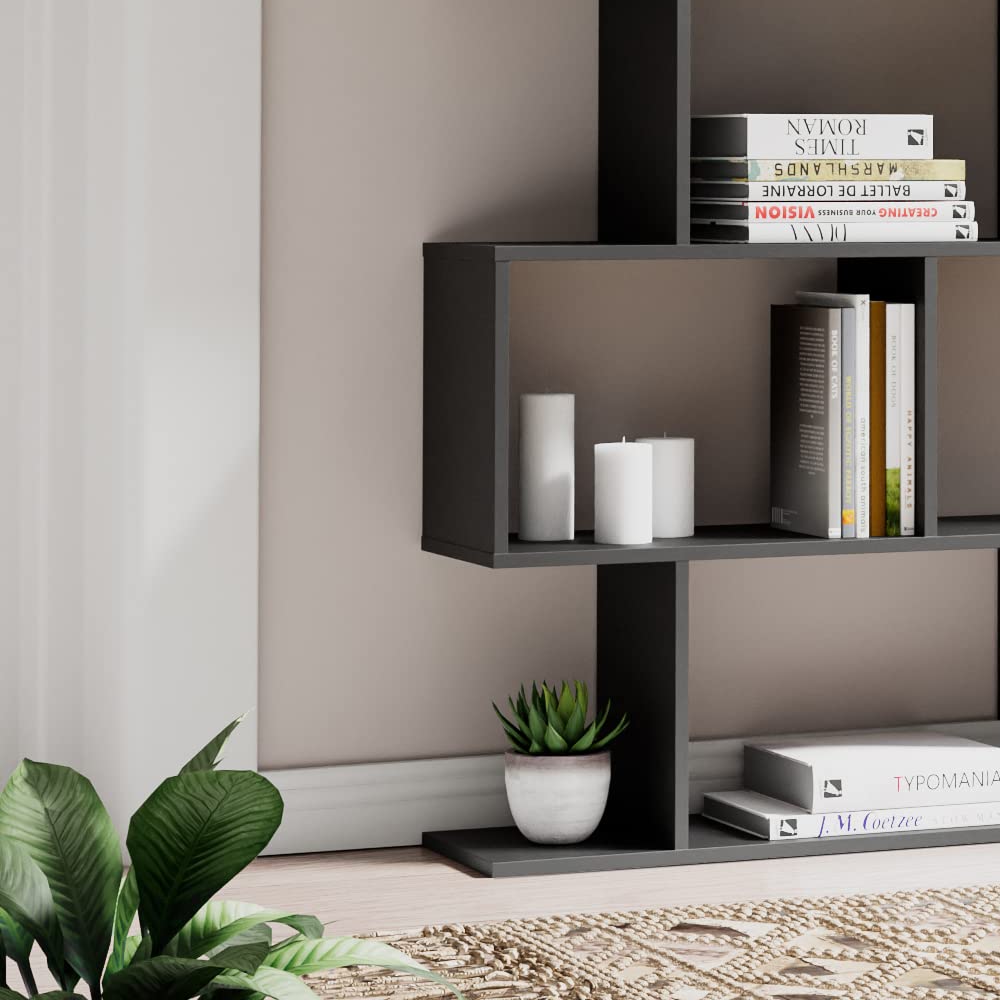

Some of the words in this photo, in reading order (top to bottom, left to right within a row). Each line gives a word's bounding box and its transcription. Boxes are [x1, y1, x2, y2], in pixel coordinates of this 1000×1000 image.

[785, 119, 867, 135] ROMAN
[794, 139, 859, 156] TIMES
[774, 163, 898, 176] MARSHLANDS
[761, 185, 833, 197] LORRAINE
[838, 185, 856, 196] DE
[860, 185, 911, 197] BALLET
[755, 206, 815, 219] VISION
[878, 207, 938, 217] CREATING
[831, 360, 838, 372] OF
[817, 815, 829, 838] J.
[838, 813, 857, 832] M.
[862, 812, 923, 831] Coetzee
